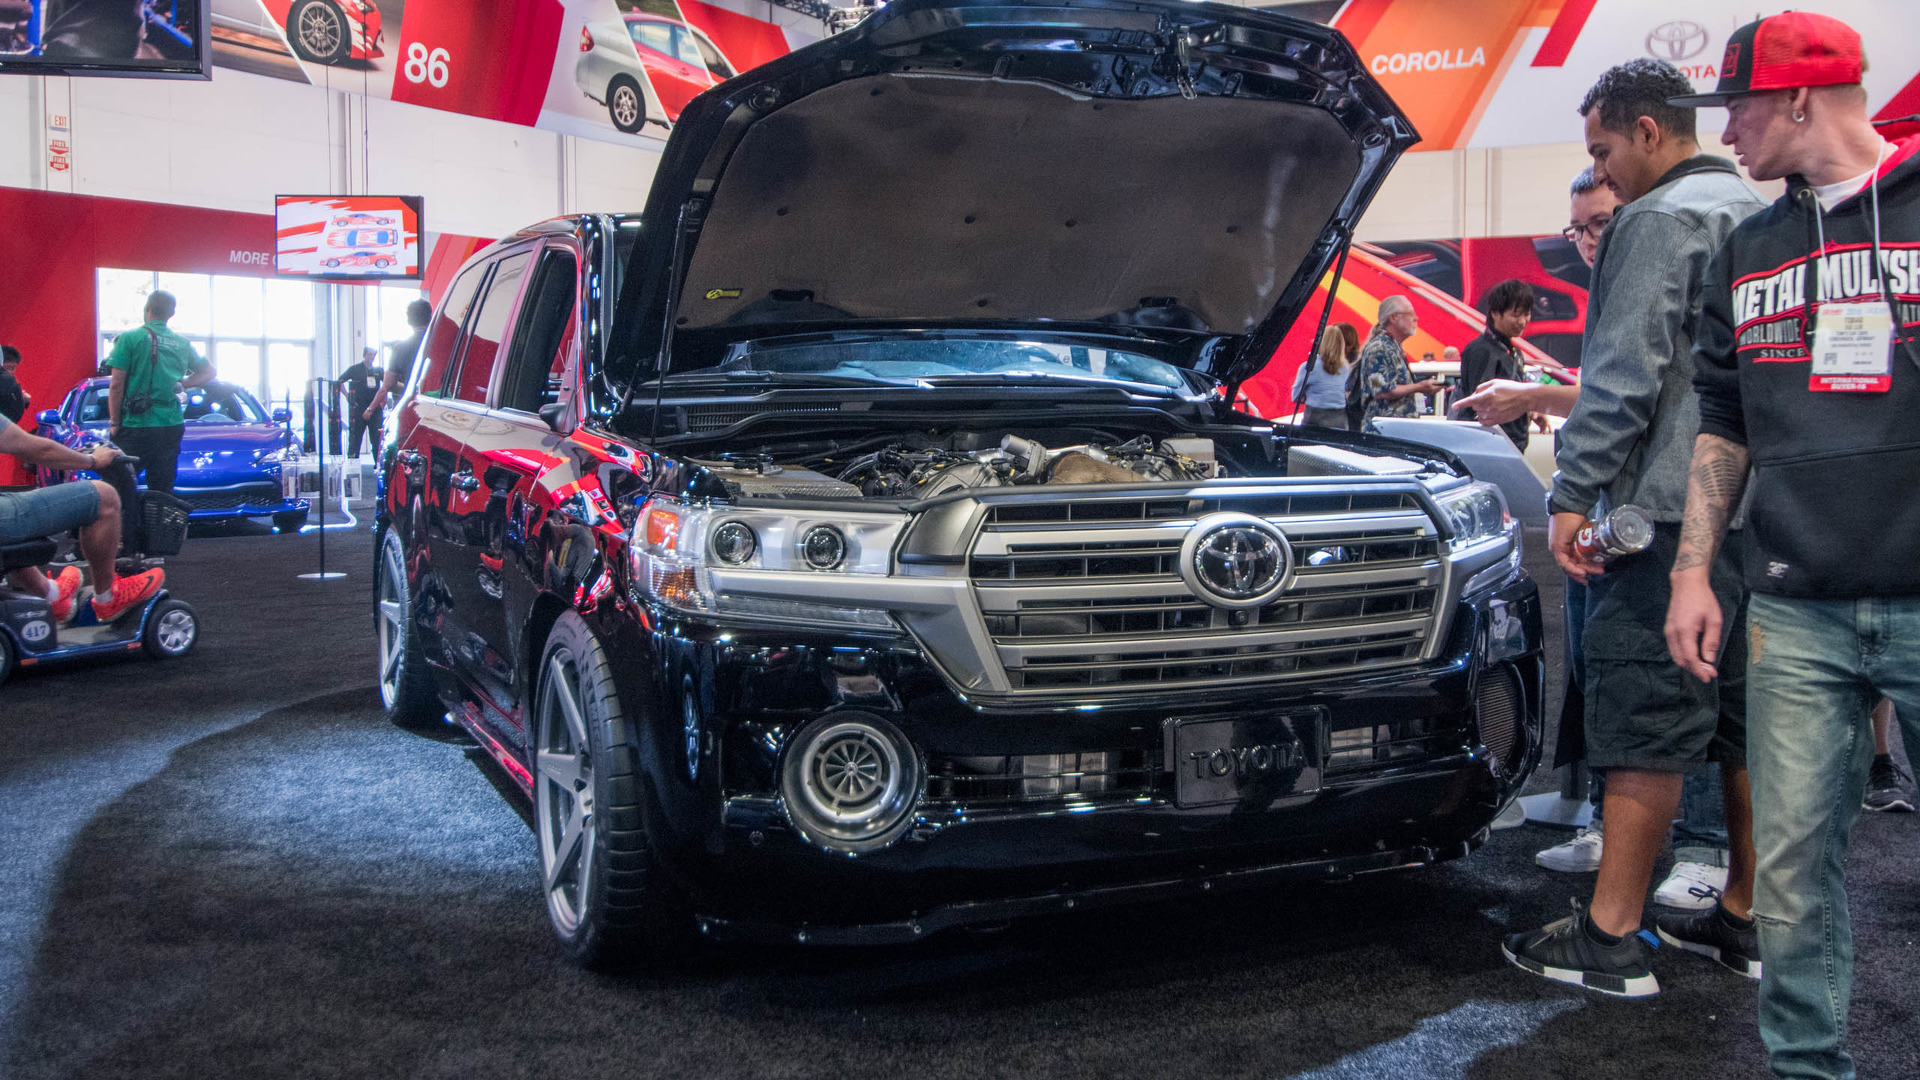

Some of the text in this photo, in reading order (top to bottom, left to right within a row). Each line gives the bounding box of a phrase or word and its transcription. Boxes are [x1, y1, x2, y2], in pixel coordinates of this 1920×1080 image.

[404, 42, 451, 89] 86
[1371, 46, 1486, 75] COROLLA
[1679, 65, 1717, 79] OTA
[54, 115, 67, 127] EXIT
[230, 250, 270, 265] MORE
[1732, 262, 1806, 329] METAL
[1761, 347, 1805, 358] SINCE
[26, 625, 47, 638] 417
[1189, 741, 1305, 779] TOYOTA
